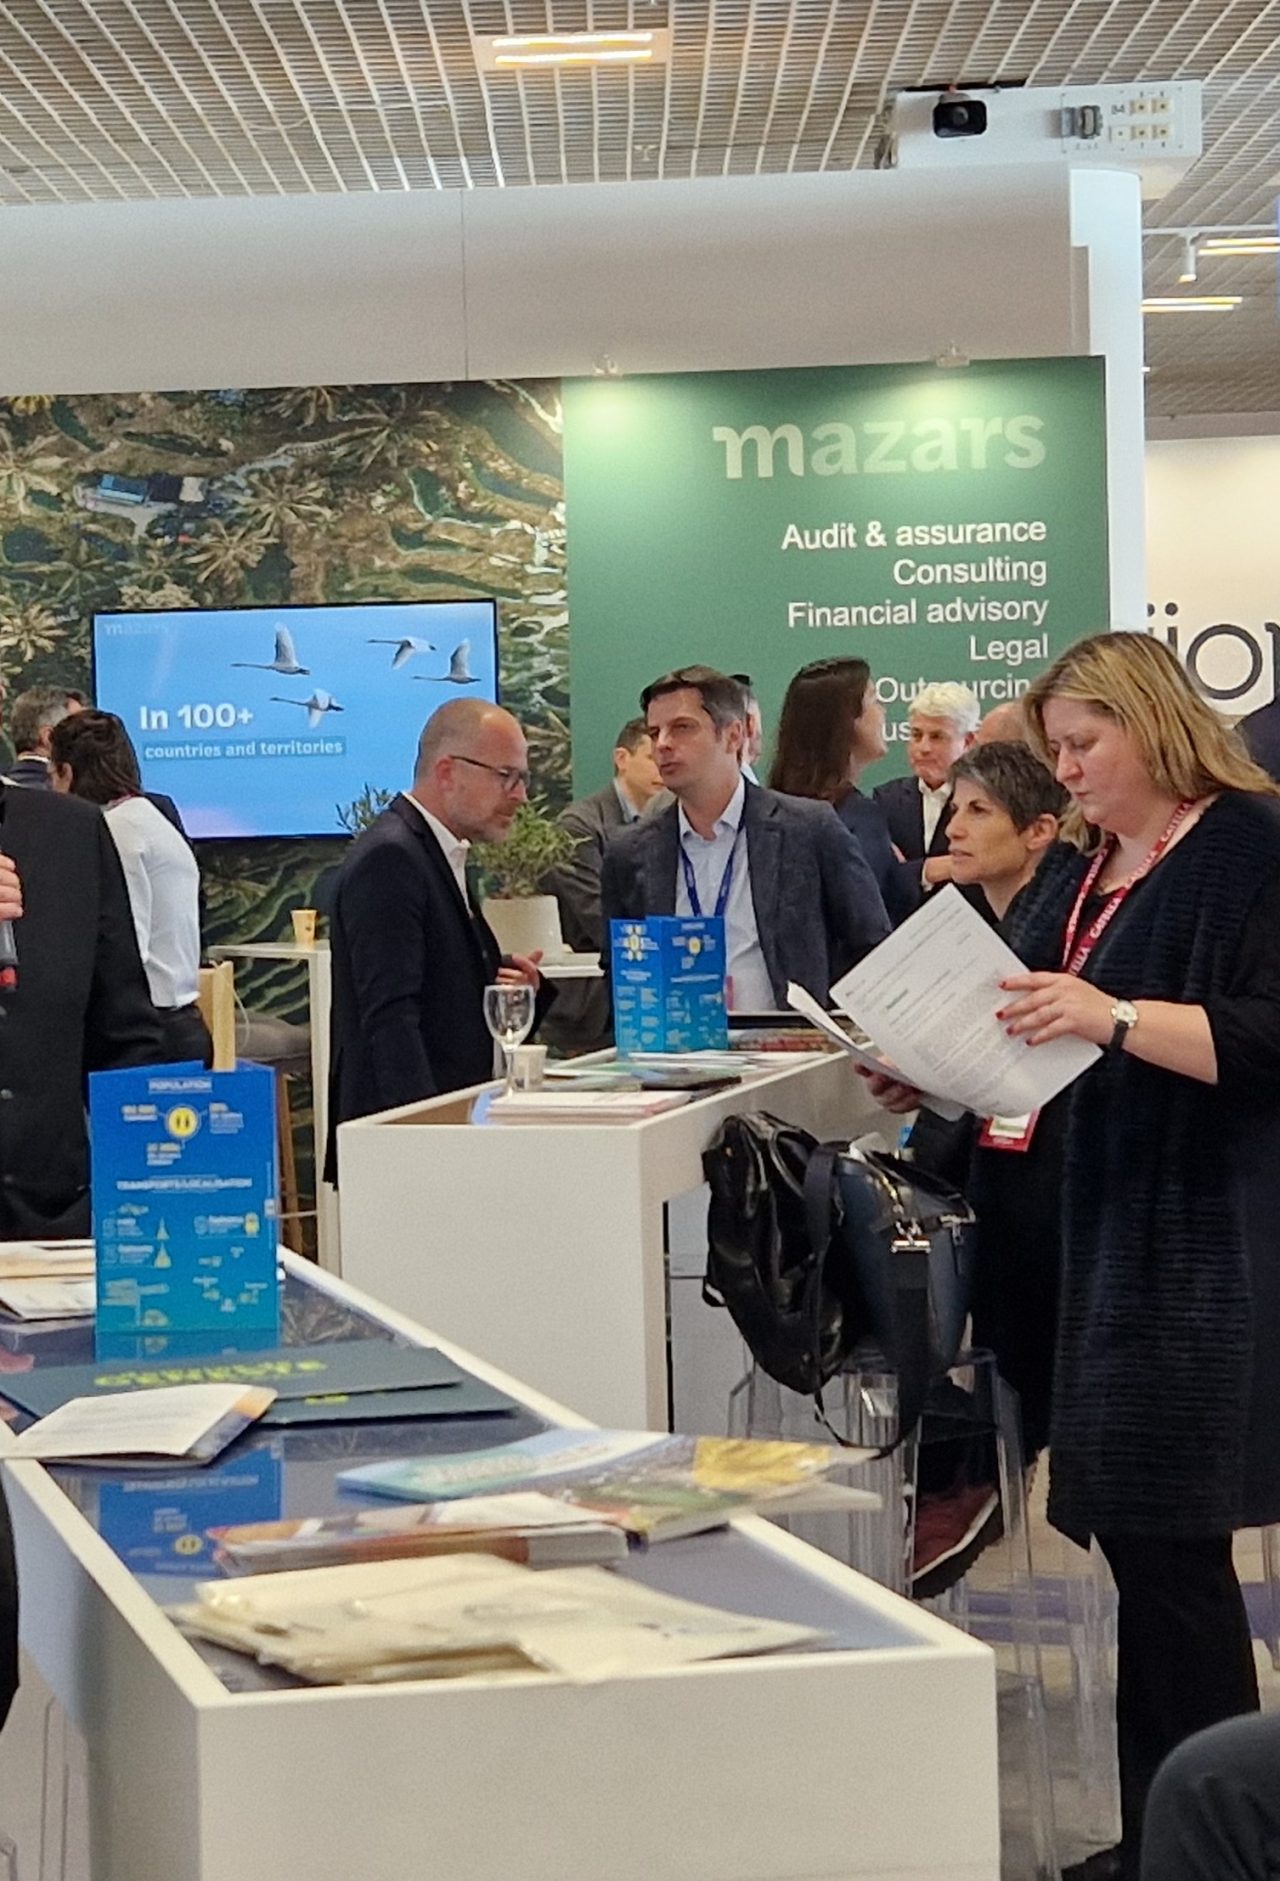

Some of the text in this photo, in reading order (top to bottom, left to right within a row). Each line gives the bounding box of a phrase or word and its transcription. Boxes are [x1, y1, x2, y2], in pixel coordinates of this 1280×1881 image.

[713, 413, 1046, 480] mazars
[782, 520, 1047, 550] Audit & assurance
[893, 556, 1047, 587] Consulting
[788, 596, 1049, 628] Financial advisory
[970, 633, 1048, 666] Legal
[140, 703, 254, 730] In 100+
[145, 740, 343, 759] countries and territories
